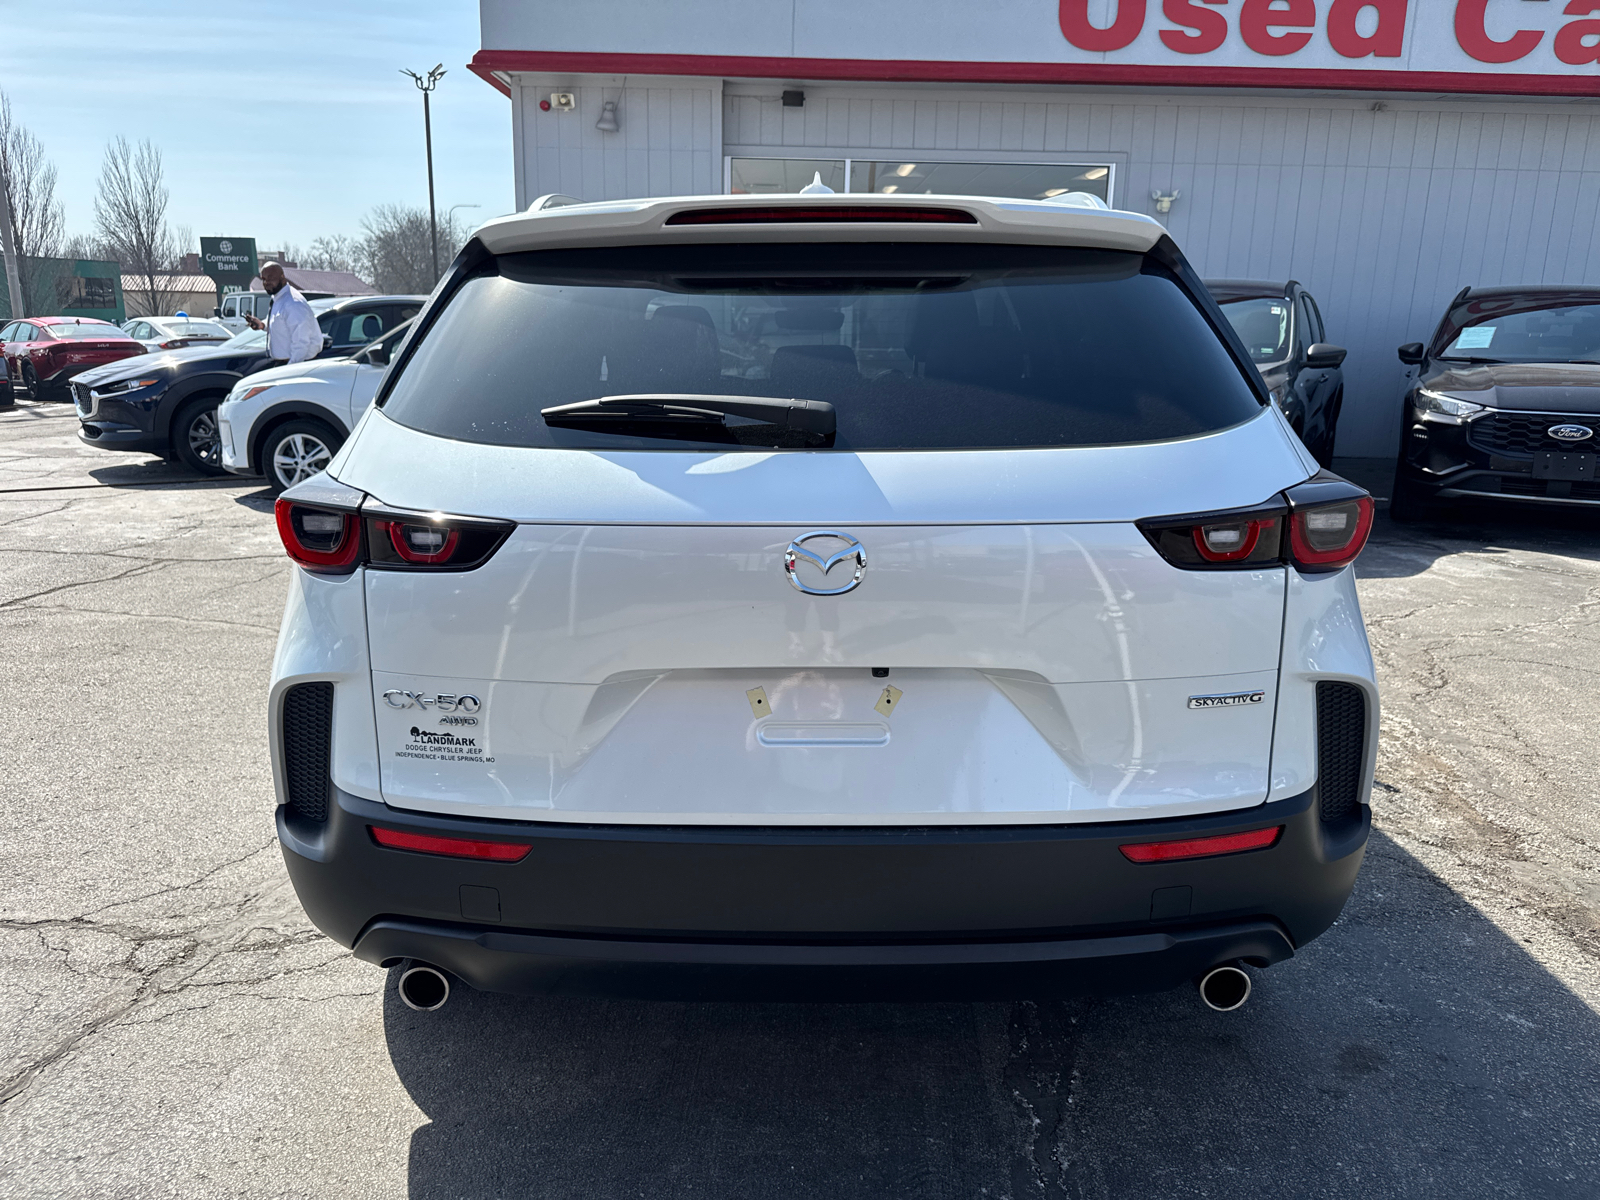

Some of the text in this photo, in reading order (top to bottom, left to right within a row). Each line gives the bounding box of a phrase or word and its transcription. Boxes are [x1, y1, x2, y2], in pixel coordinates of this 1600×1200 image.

[1058, 0, 1406, 58] Used
[205, 253, 249, 262] Commerce
[217, 262, 239, 271] Bank
[223, 285, 243, 293] ATM
[1557, 427, 1583, 437] Ford
[382, 689, 482, 714] CX-50
[438, 715, 479, 726] AWD
[420, 736, 476, 746] LANDMARK
[405, 744, 483, 755] DODGE CHRYSLER JEEP
[395, 751, 436, 760] INDEPENDENCE
[440, 753, 456, 761] BLUE
[457, 755, 485, 763] SPRINGS,
